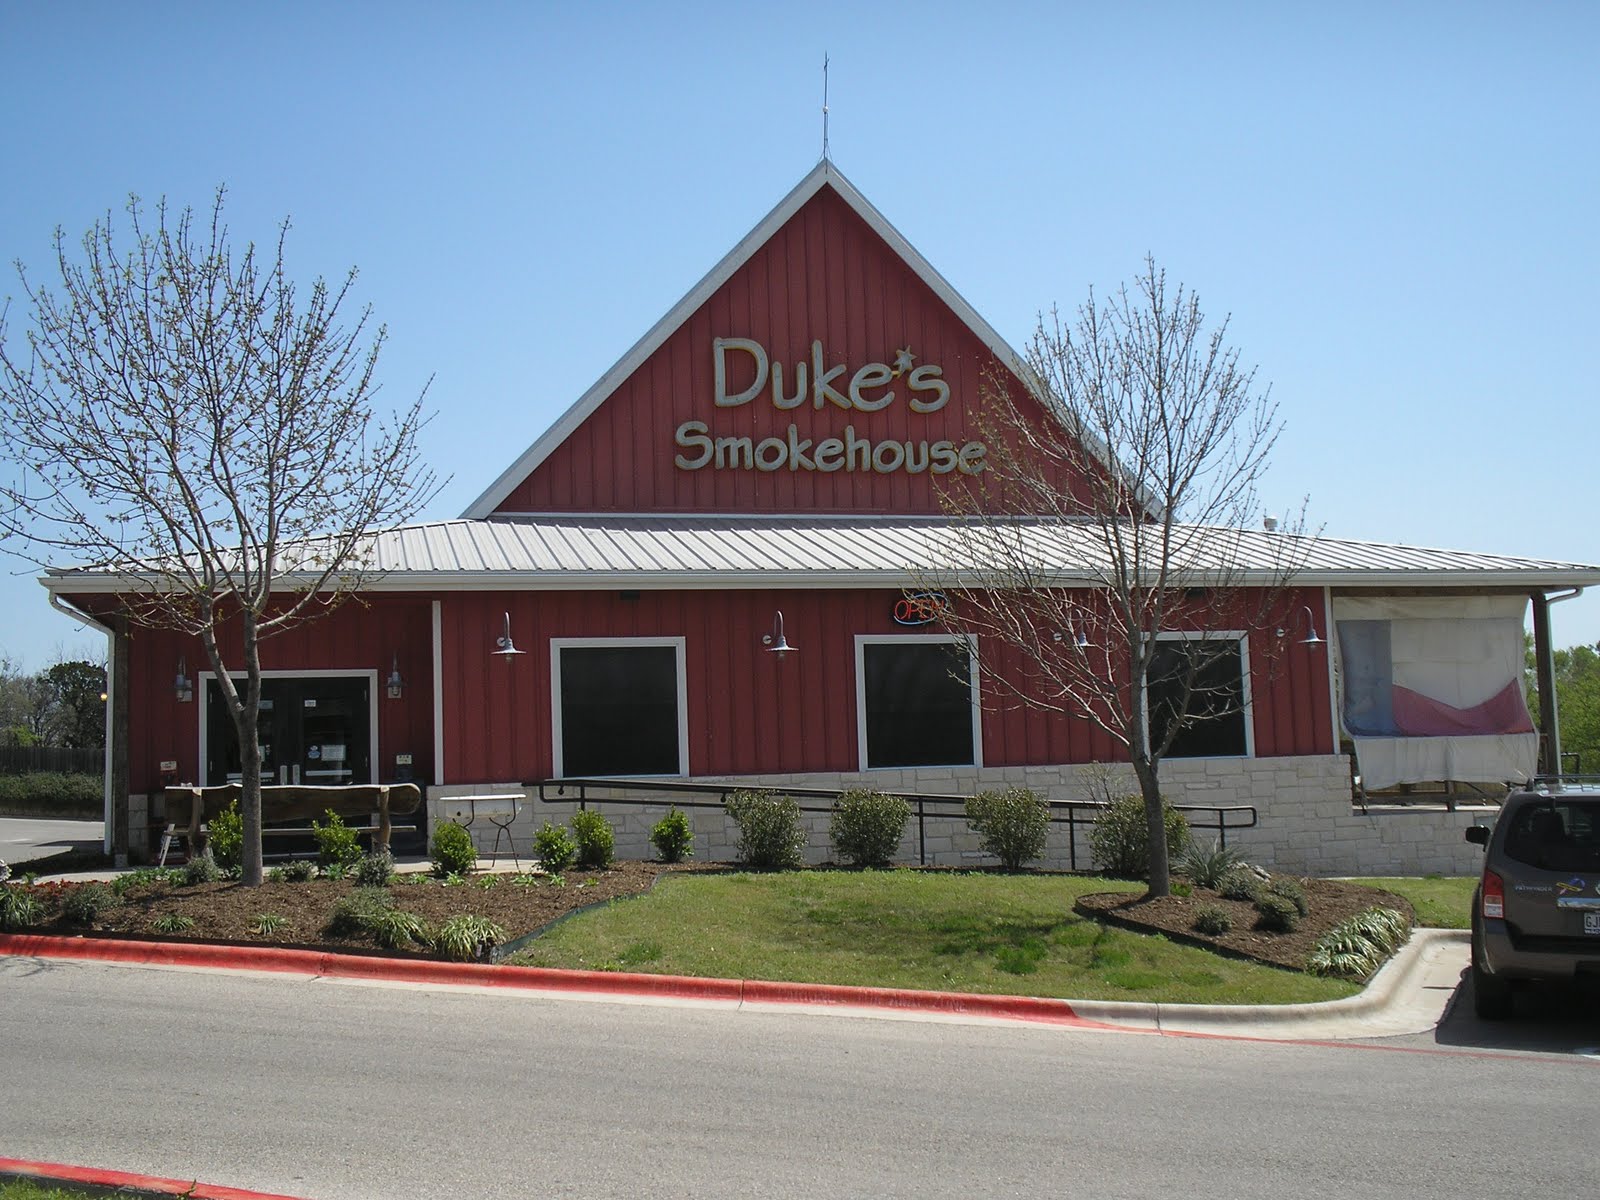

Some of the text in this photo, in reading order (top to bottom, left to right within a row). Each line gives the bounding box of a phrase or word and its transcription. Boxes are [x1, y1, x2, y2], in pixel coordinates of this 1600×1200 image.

[714, 337, 950, 413] Duke's
[675, 421, 988, 474] Smokehouse
[1585, 916, 1600, 927] GJ
